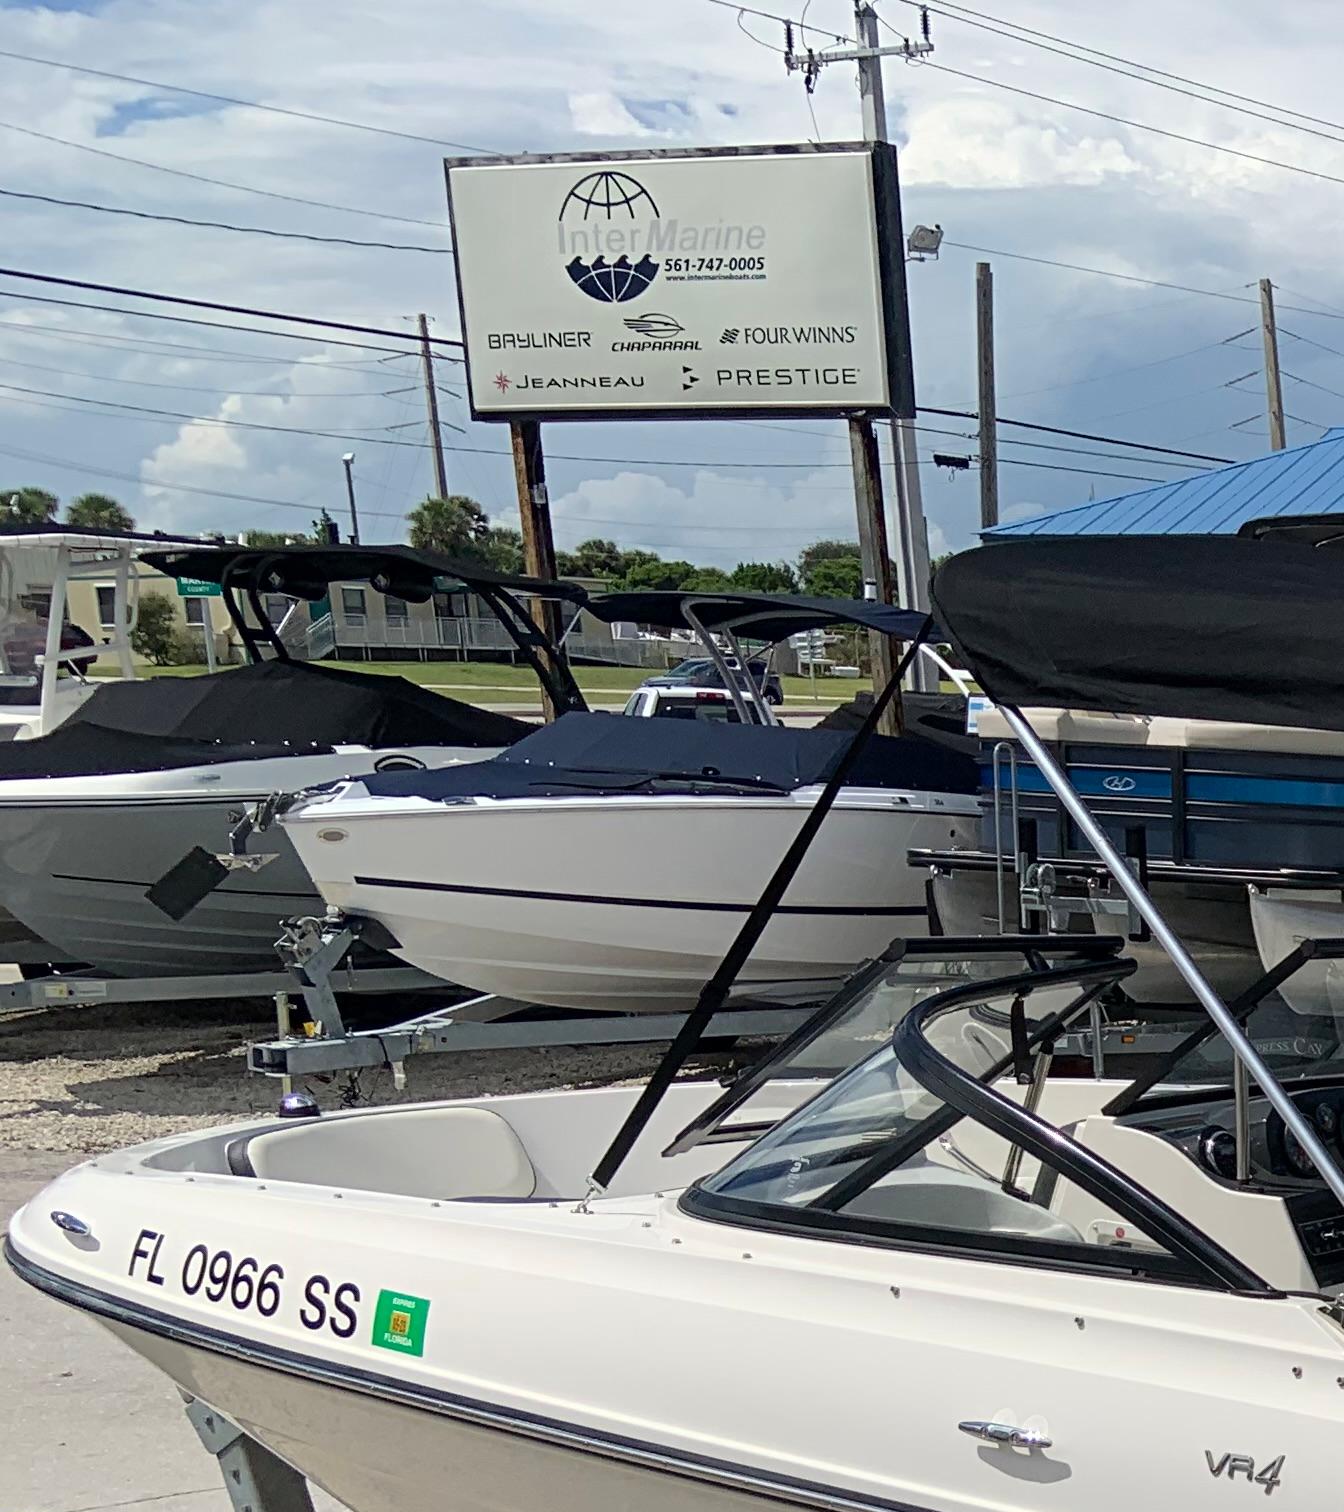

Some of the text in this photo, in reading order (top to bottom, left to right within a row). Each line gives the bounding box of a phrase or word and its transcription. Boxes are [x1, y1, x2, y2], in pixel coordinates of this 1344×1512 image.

[664, 257, 766, 272] 561-747-0005
[488, 332, 591, 349] BAYLINER
[744, 326, 855, 344] FOUR WINNS
[611, 340, 702, 352] CHAPARRAL
[516, 375, 644, 389] JEANNEAU
[717, 368, 857, 386] PRESTIGE
[128, 1228, 361, 1339] FL 0966 SS
[384, 1332, 413, 1347] FLORIDA
[1204, 1449, 1287, 1497] VR4
